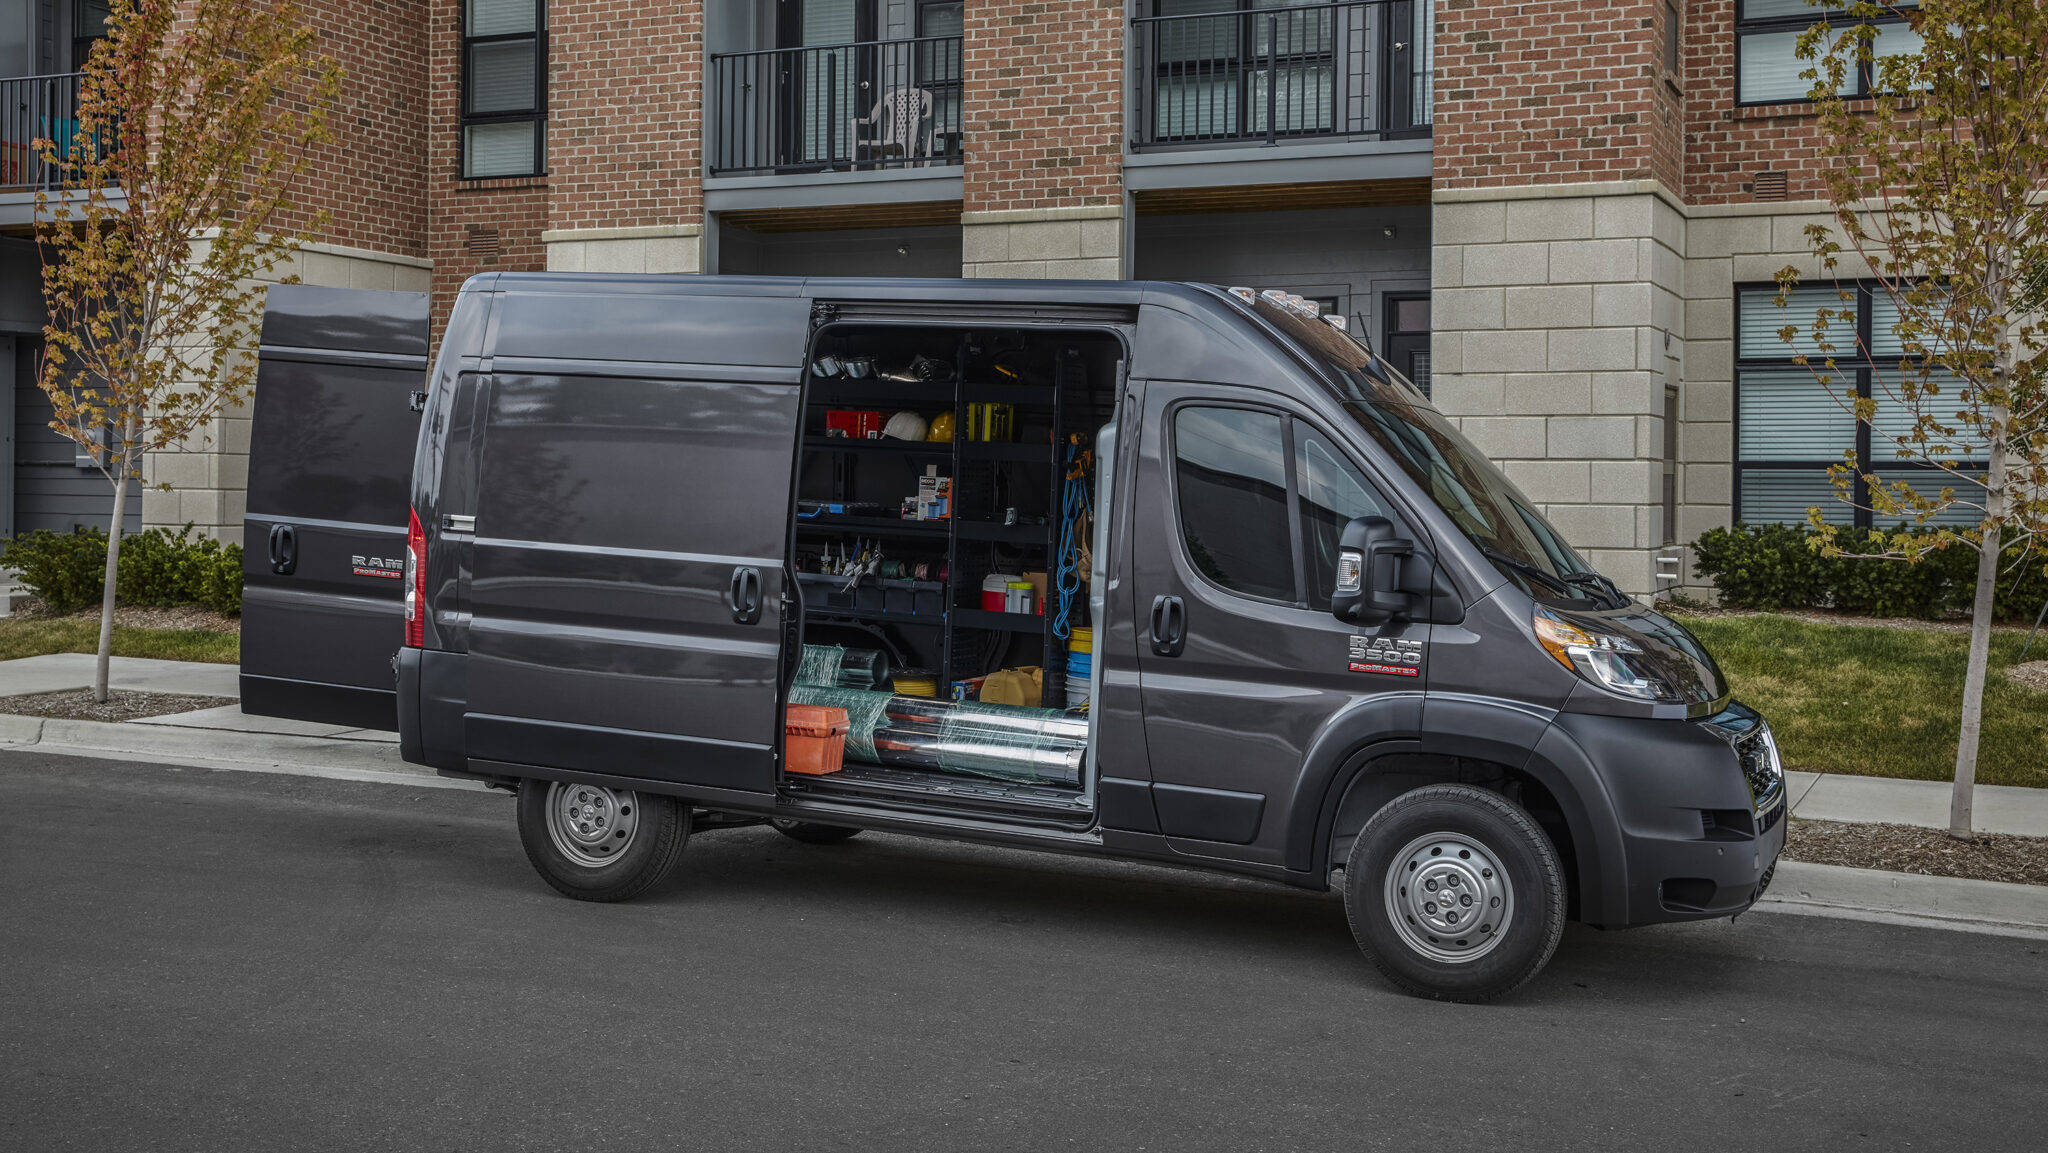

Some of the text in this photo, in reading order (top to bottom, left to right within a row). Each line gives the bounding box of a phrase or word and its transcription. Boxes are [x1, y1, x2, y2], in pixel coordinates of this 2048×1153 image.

[352, 555, 403, 569] RAM
[1349, 635, 1422, 652] RAM
[1349, 647, 1421, 664] 3500
